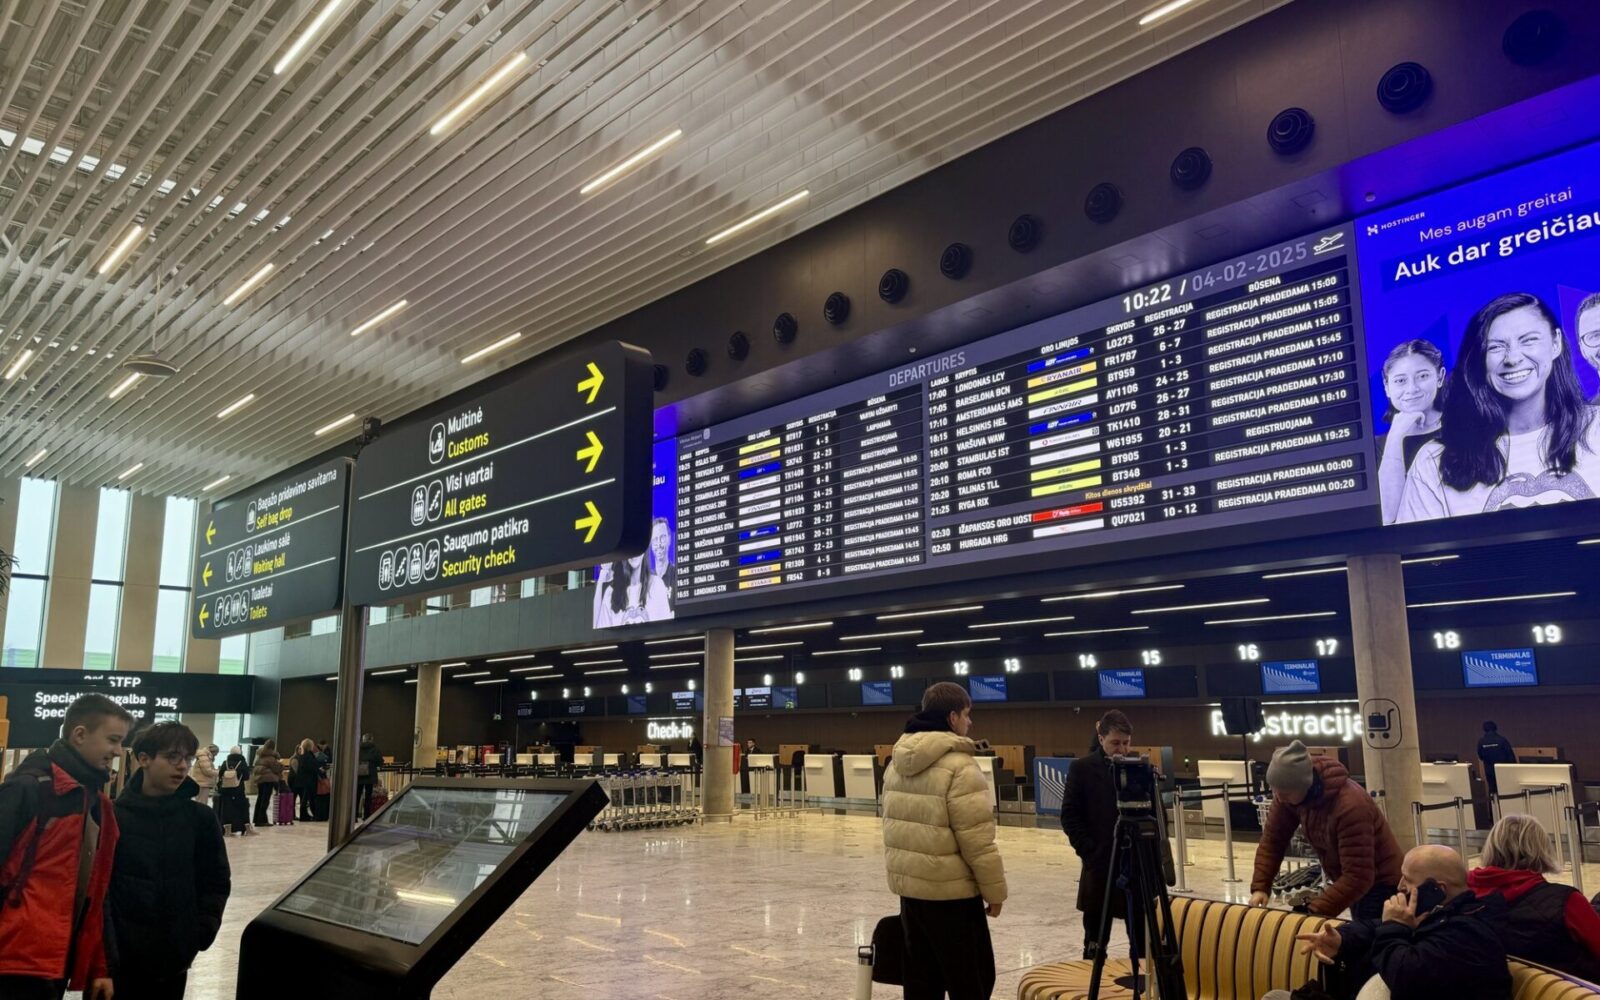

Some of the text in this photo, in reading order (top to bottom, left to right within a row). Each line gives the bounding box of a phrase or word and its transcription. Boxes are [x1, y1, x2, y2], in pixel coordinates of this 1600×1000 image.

[1380, 211, 1425, 230] HOSTINGER
[1419, 186, 1572, 242] Mes augam greitai
[1394, 253, 1441, 281] Auk
[1447, 241, 1490, 265] dar
[1122, 241, 1306, 312] 10:22 / 04-02-2025
[1248, 275, 1281, 292] BŪSENA
[1205, 275, 1337, 320] REGISTRACIJA PRADEDAMA 15:00
[1144, 302, 1193, 323] REGISTRACIJA
[1206, 294, 1338, 338] REGISTRACIJA PRADEDAMA 15:05
[1105, 319, 1135, 335] SKRYDIS
[1207, 313, 1340, 355] REGISTRACIJA PRADEDAMA 15:10
[1040, 343, 1054, 354] ORO
[1208, 331, 1341, 373] REGISTRACIJA PRADEDAMA 15:45
[1104, 349, 1137, 367] FR1787
[889, 351, 966, 387] DEPARTURES
[1047, 367, 1081, 381] RYANAIR
[1107, 366, 1135, 382] BT959
[1209, 350, 1343, 390] REGISTRACIJA PRADEDAMA 17:10
[954, 370, 1005, 393] LONDONAS LCY
[1105, 382, 1138, 399] AY1106
[1210, 369, 1345, 408] REGISTRACIJA PRADEDAMA 17:30
[928, 388, 947, 401] 17:00
[955, 389, 995, 408] BARSELONA
[928, 402, 947, 415] 17:05
[955, 396, 1023, 422] AMSTERDAMAS AMS
[1042, 399, 1082, 414] FINNAIR
[1212, 388, 1347, 426] REGISTRACIJA PRADEDAMA 18:10
[447, 406, 483, 434] Muitinė
[928, 416, 948, 429] 17:10
[955, 416, 1007, 437] HELSINKIS HEL
[1106, 415, 1140, 432] TK1410
[1245, 415, 1313, 437] REGISTRUOJAMA
[447, 432, 489, 458] Customs
[956, 432, 1005, 451] VARŠUVA WAW
[1106, 432, 1142, 449] W61955
[1214, 427, 1350, 461] REGISTRACIJA PRADEDAMA 19:25
[956, 446, 1010, 466] STAMBULAS IST
[1111, 450, 1139, 465] BT905
[929, 460, 949, 472] 20:00
[957, 465, 992, 481] ROMA FCO
[1111, 467, 1140, 481] BT348
[1216, 458, 1353, 490] REGISTRACIJA PRADEDAMA 00:00
[445, 461, 493, 492] Visi vartai
[929, 474, 949, 487] 20:10
[257, 469, 337, 511] Bagažo pridavimo savitarna
[957, 479, 1000, 495] TALINAS TLL
[1217, 478, 1355, 508] REGISTRACIJA PRADEDAMA 00:20
[444, 493, 486, 517] All gates
[930, 504, 950, 516] 21:25
[958, 496, 989, 510] RYGA RIX
[255, 506, 292, 529] Self bag drop
[1110, 511, 1145, 527] QU7021
[253, 531, 290, 556] Laukimo salė
[442, 517, 529, 552] Saugumo patikra
[959, 533, 1008, 549] HURGADA HRG
[931, 542, 951, 553] 02:50
[253, 552, 285, 574] Waiting hall
[441, 544, 515, 577] Security check
[250, 582, 273, 600] Tualetai
[249, 605, 267, 619] Toilets
[1433, 631, 1461, 649] 18
[1532, 624, 1562, 644] 19
[1237, 644, 1260, 660] 16
[1316, 639, 1338, 656] 17
[1490, 651, 1531, 660] TERMINALAS
[1003, 658, 1020, 672] 13
[1078, 654, 1097, 669] 14
[1141, 650, 1161, 665] 15
[1284, 662, 1316, 670] TERMINALAS
[848, 668, 863, 682] 10
[890, 665, 904, 679] 11
[953, 661, 969, 675] 12
[647, 721, 693, 740] Check-in
[1210, 707, 1364, 742] Ristracija
